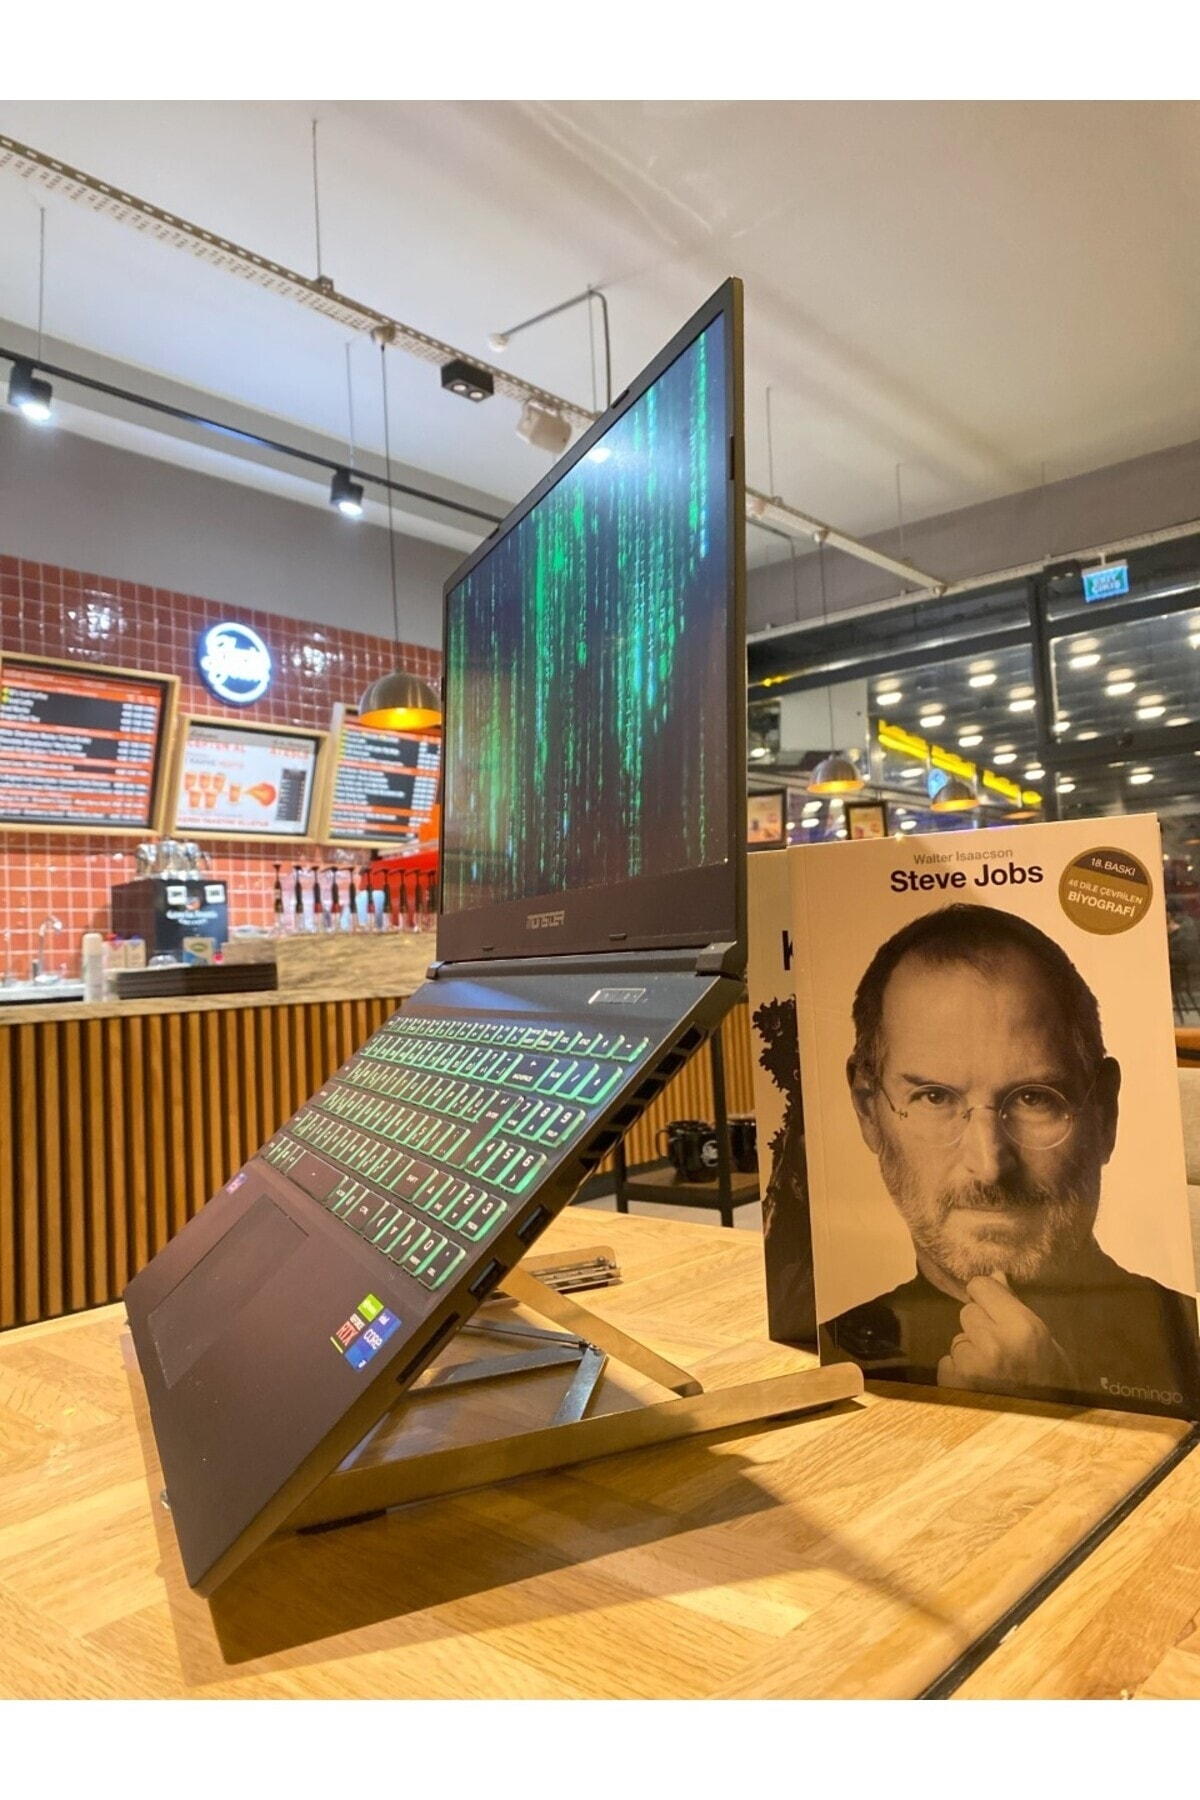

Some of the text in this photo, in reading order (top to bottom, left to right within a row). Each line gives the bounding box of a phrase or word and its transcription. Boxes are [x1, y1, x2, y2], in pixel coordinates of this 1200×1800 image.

[913, 849, 1014, 865] Walter Isaacson
[1091, 857, 1136, 876] 18. BASKI
[890, 862, 1044, 893] Steve Jobs
[1099, 887, 1144, 904] ÇEVRİLEN
[1068, 890, 1136, 917] BİYOGRAFİ
[520, 1102, 532, 1113] 7
[540, 1107, 551, 1118] 8
[560, 1112, 572, 1124] 9
[503, 1148, 515, 1160] 5
[522, 1155, 535, 1167] 6
[463, 1193, 475, 1205] 2
[482, 1202, 494, 1215] 3
[1109, 1382, 1184, 1405] domingo
